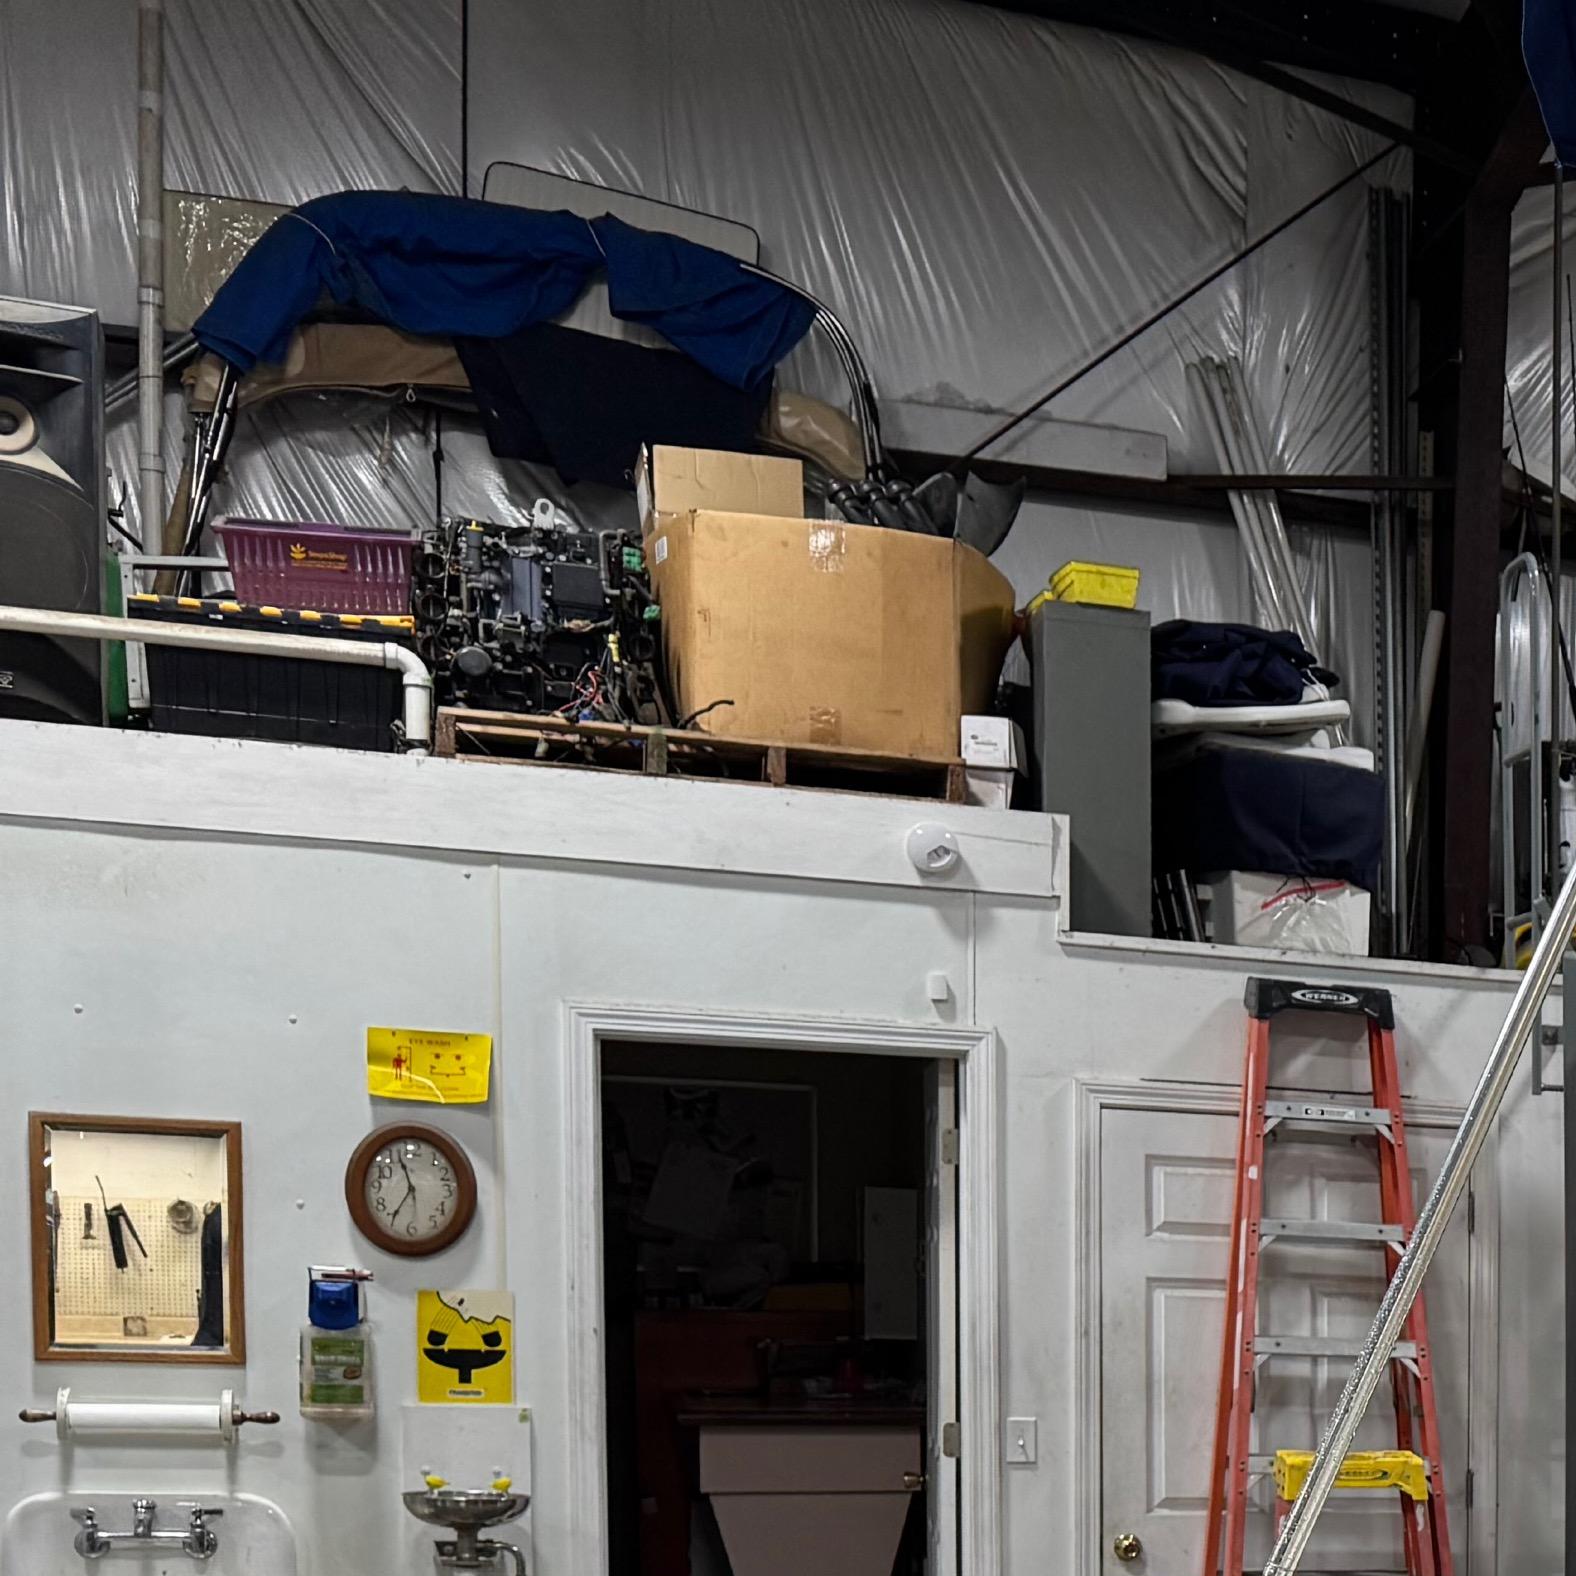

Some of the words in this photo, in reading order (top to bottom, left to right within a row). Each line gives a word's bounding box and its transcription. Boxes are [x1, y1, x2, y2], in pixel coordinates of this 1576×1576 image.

[440, 1167, 450, 1182] 2
[371, 1180, 382, 1199] 9
[443, 1183, 453, 1199] 3
[375, 1196, 387, 1213] 8
[435, 1201, 445, 1217] 4
[406, 1221, 418, 1237] 6
[429, 1214, 438, 1230] 5
